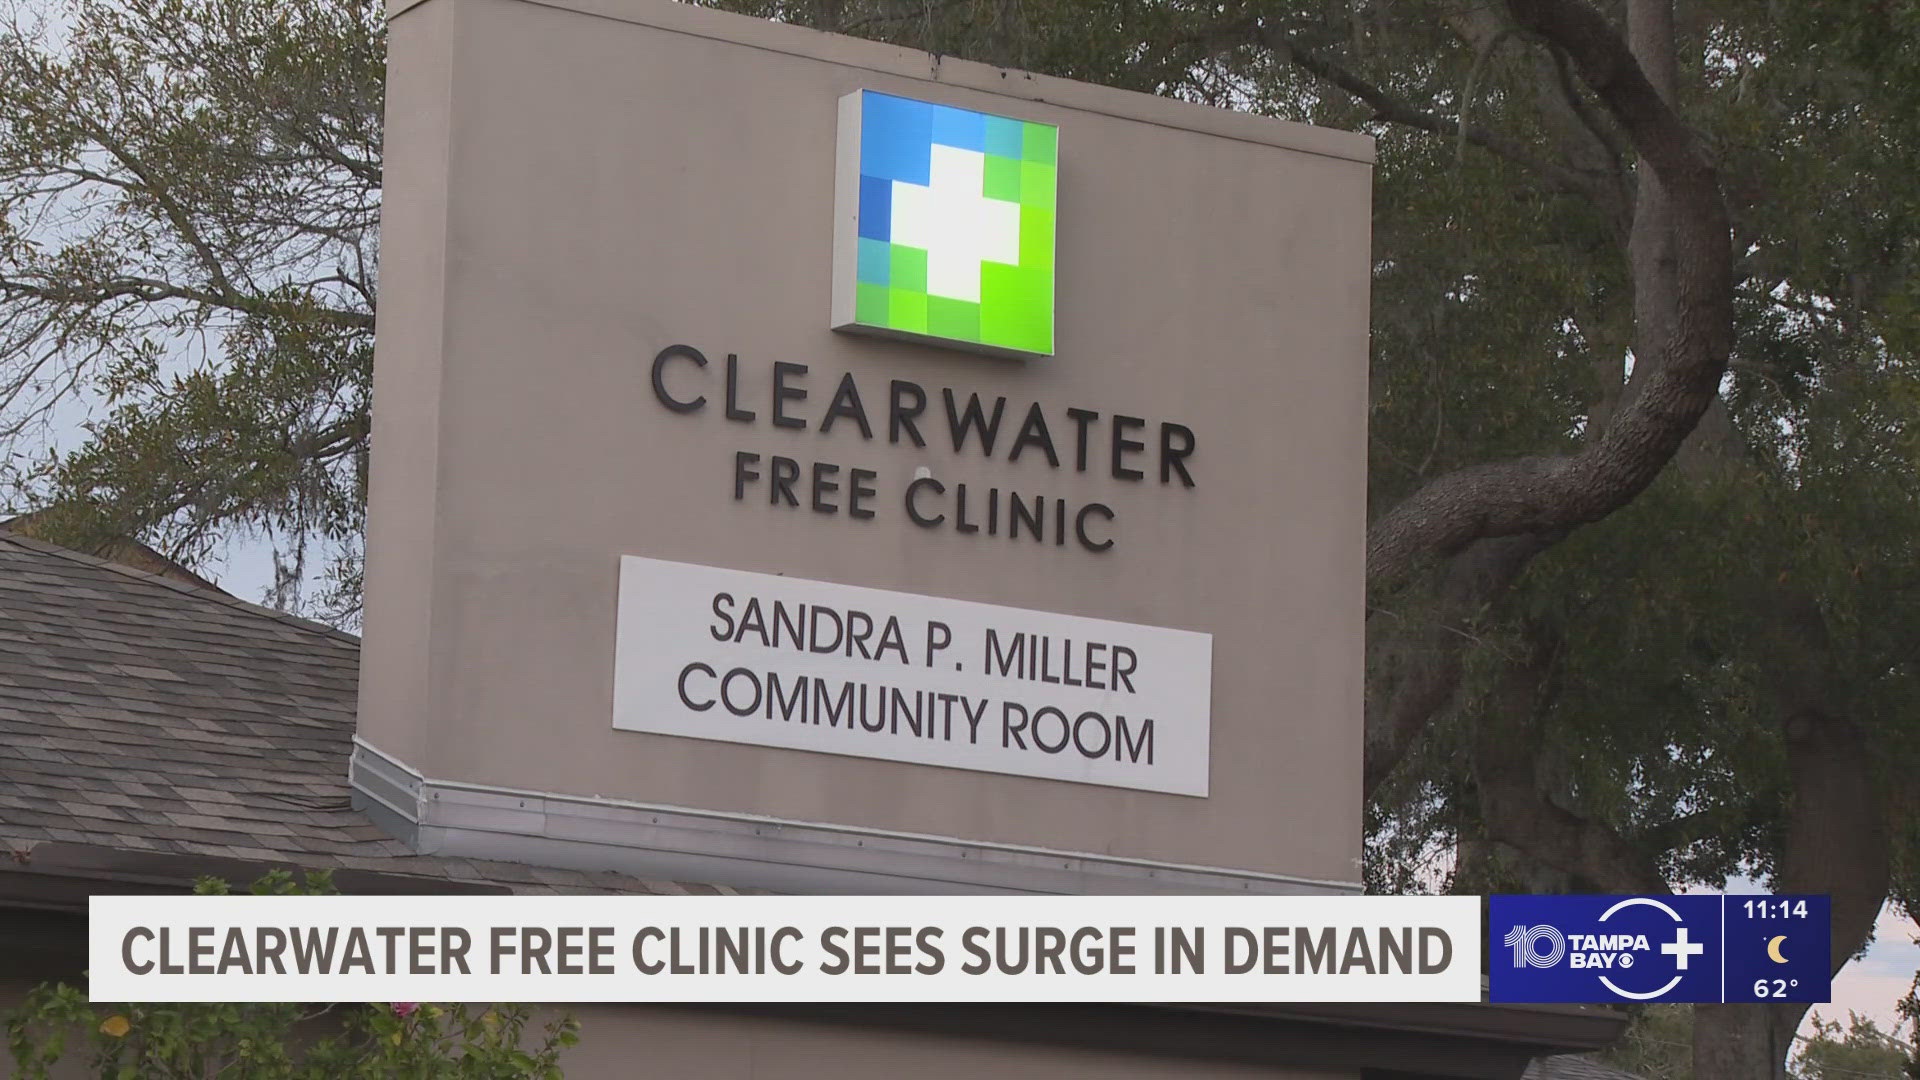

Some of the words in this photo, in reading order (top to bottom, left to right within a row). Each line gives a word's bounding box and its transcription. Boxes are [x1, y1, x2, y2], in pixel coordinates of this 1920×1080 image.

[650, 344, 1196, 491] CLEARWATER
[734, 451, 877, 521] FREE
[904, 477, 1115, 555] CLINIC
[710, 592, 910, 665] SANDRA
[926, 620, 963, 672] P.
[984, 628, 1138, 694] MILLER
[677, 661, 989, 745] COMMUNITY
[1002, 700, 1155, 766] ROOM
